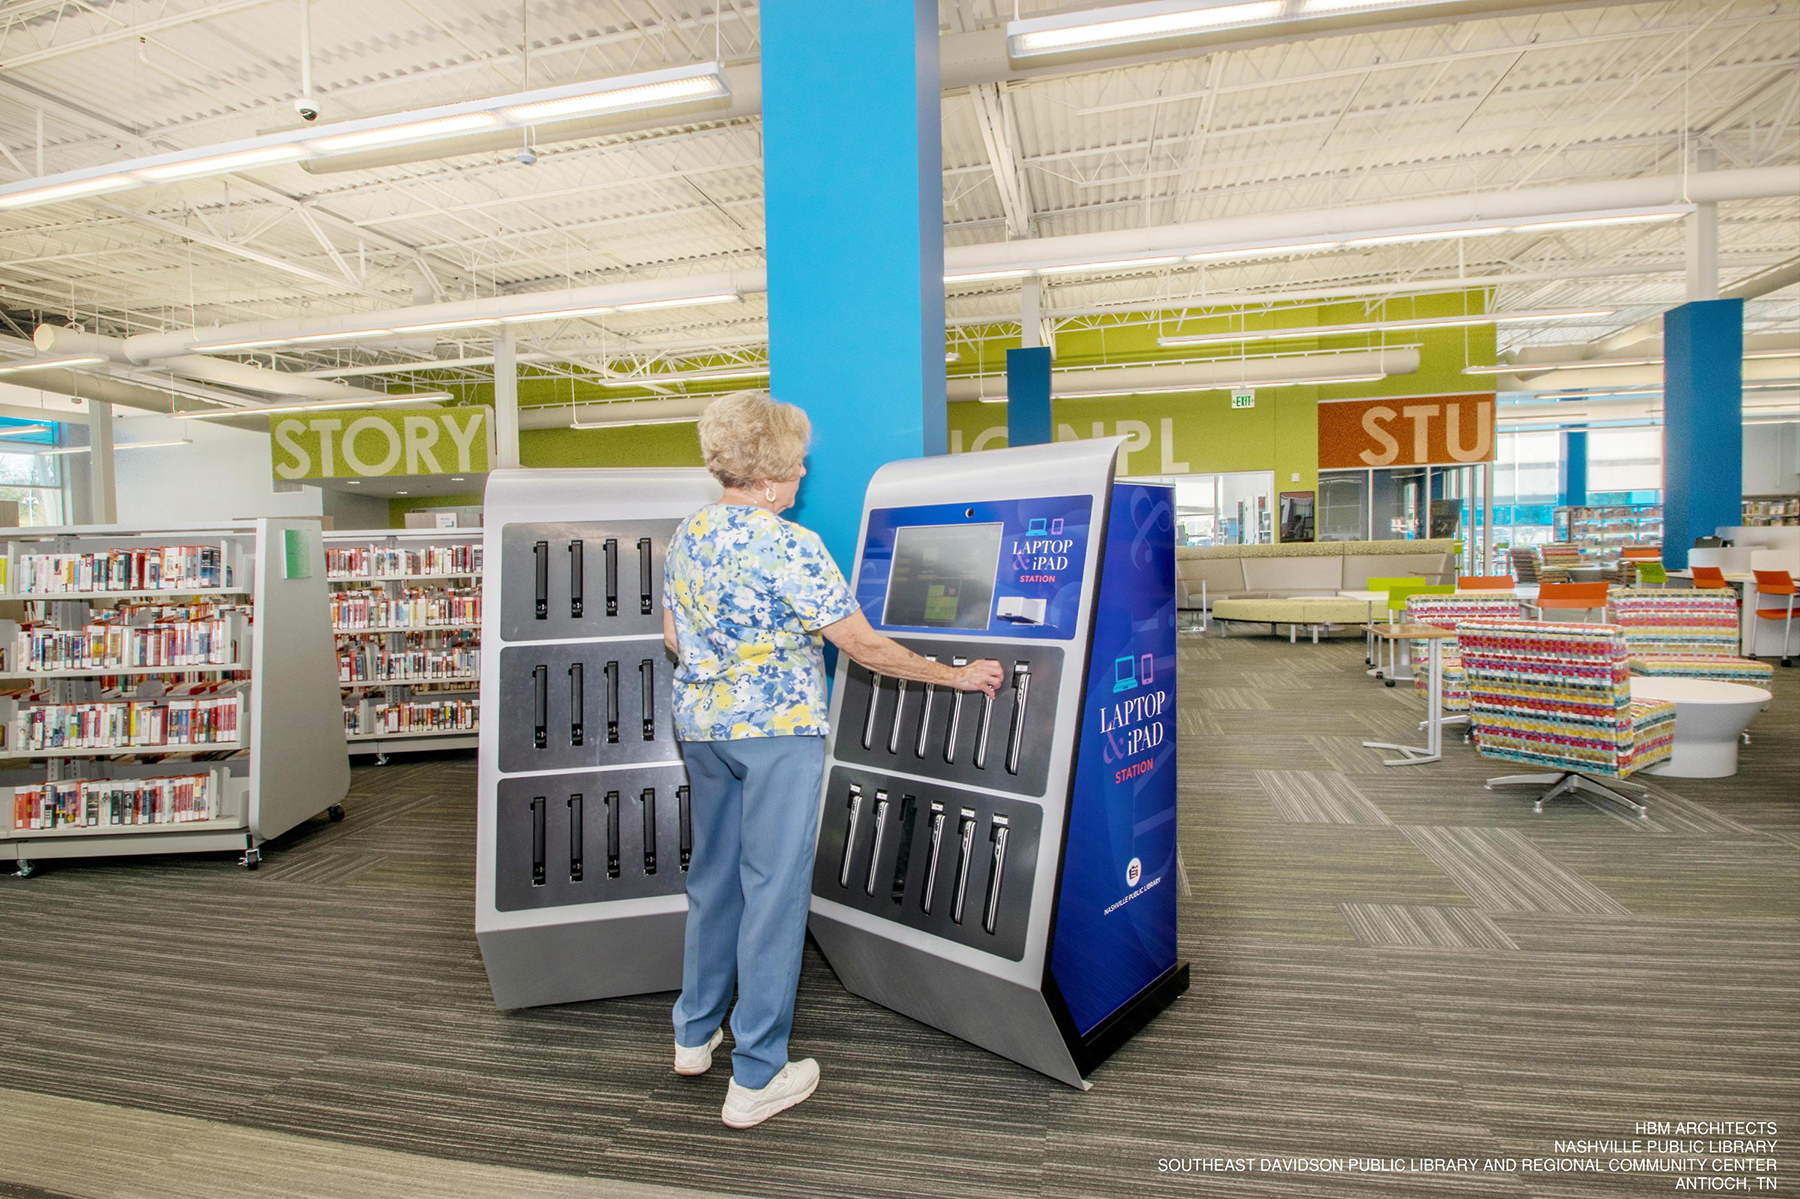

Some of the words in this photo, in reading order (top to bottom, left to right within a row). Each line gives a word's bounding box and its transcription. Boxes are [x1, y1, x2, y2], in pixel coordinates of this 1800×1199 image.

[1236, 395, 1252, 407] EXIT
[275, 413, 484, 480] STORY
[1359, 401, 1491, 466] STU
[1012, 539, 1074, 555] LAPTOP
[1012, 552, 1031, 571] &
[1032, 556, 1069, 571] iPAD
[1020, 575, 1056, 583] STATION
[1100, 690, 1166, 734] LAPTOP
[1103, 722, 1126, 765] &
[1127, 721, 1164, 757] iPAD
[1115, 758, 1154, 785] STATION
[1103, 896, 1129, 916] NASHVILLE
[1128, 887, 1144, 901] PUBLIC
[1143, 876, 1162, 892] LIBRARY
